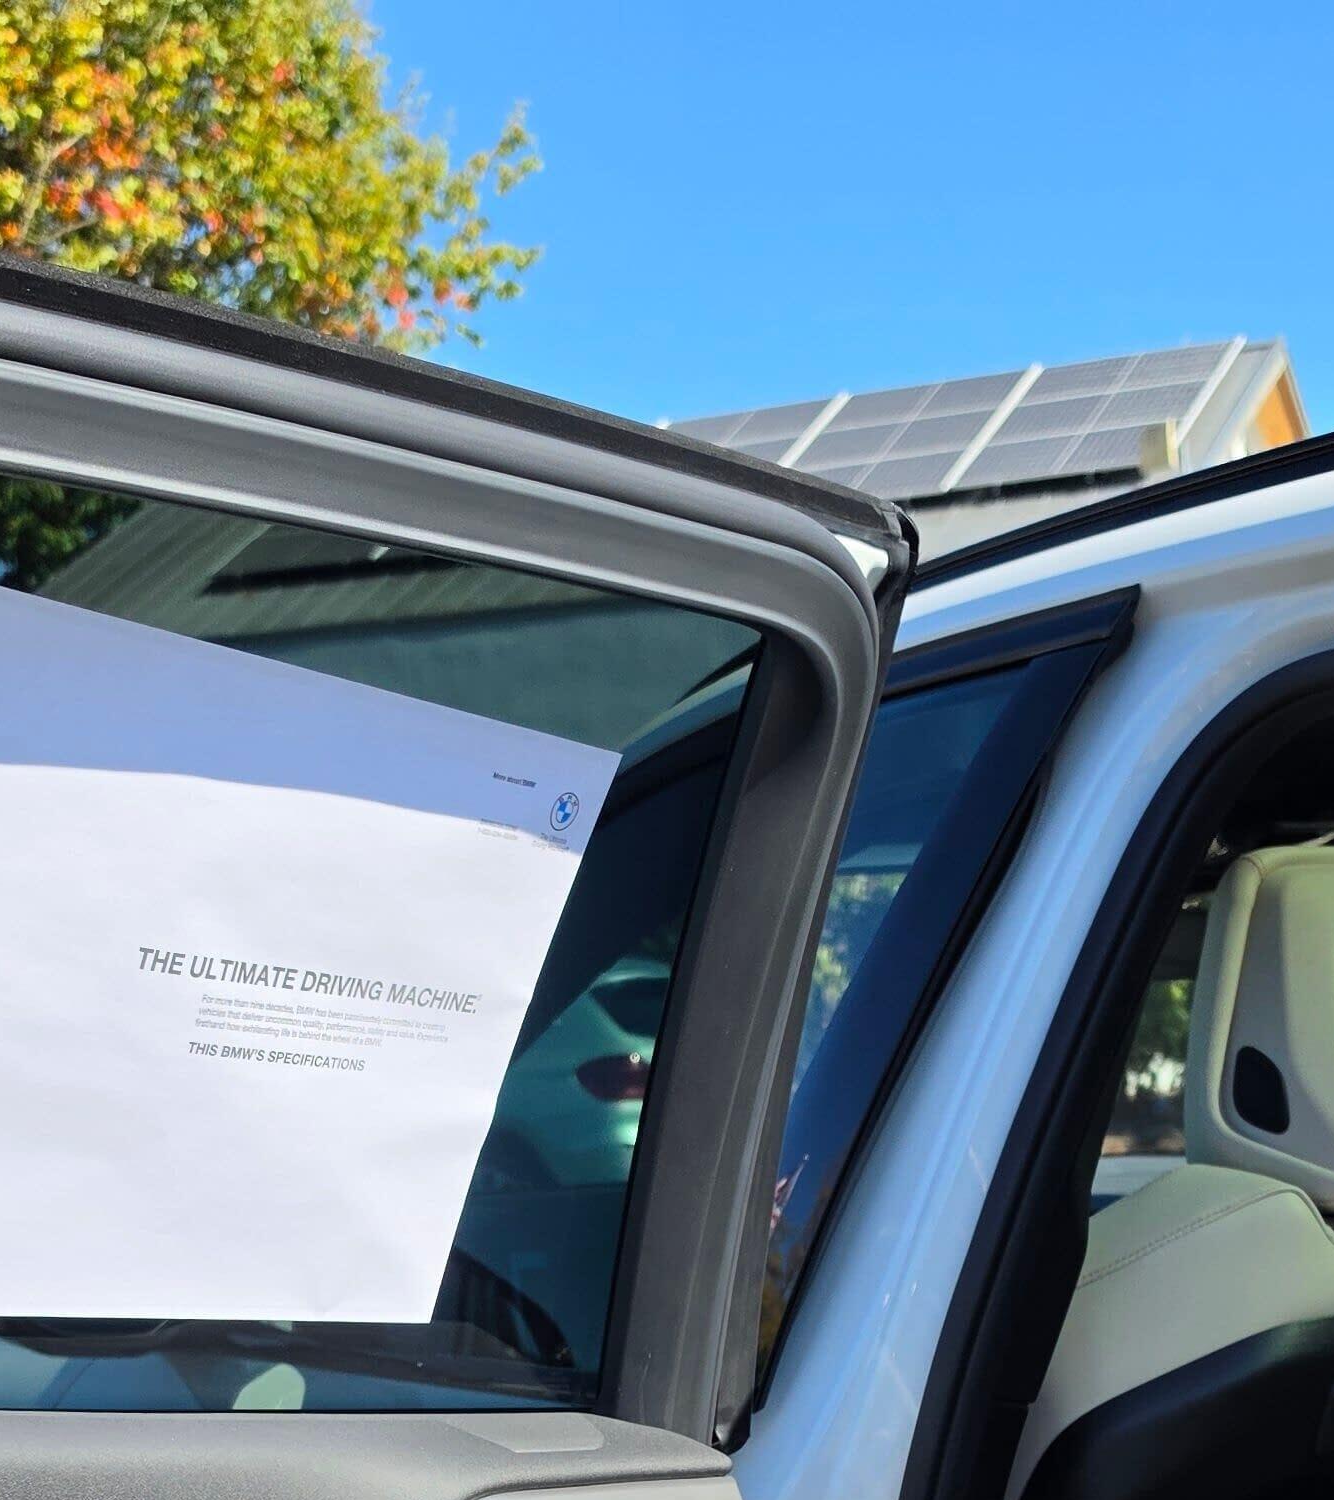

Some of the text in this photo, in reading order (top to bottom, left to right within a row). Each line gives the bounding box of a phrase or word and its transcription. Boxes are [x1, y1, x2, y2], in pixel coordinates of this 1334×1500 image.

[139, 947, 186, 975] THE
[189, 955, 298, 990] ULTIMATE
[300, 970, 383, 1001] DRIVING
[188, 1042, 366, 1071] THIS BMW'S SPECIFICATIONS
